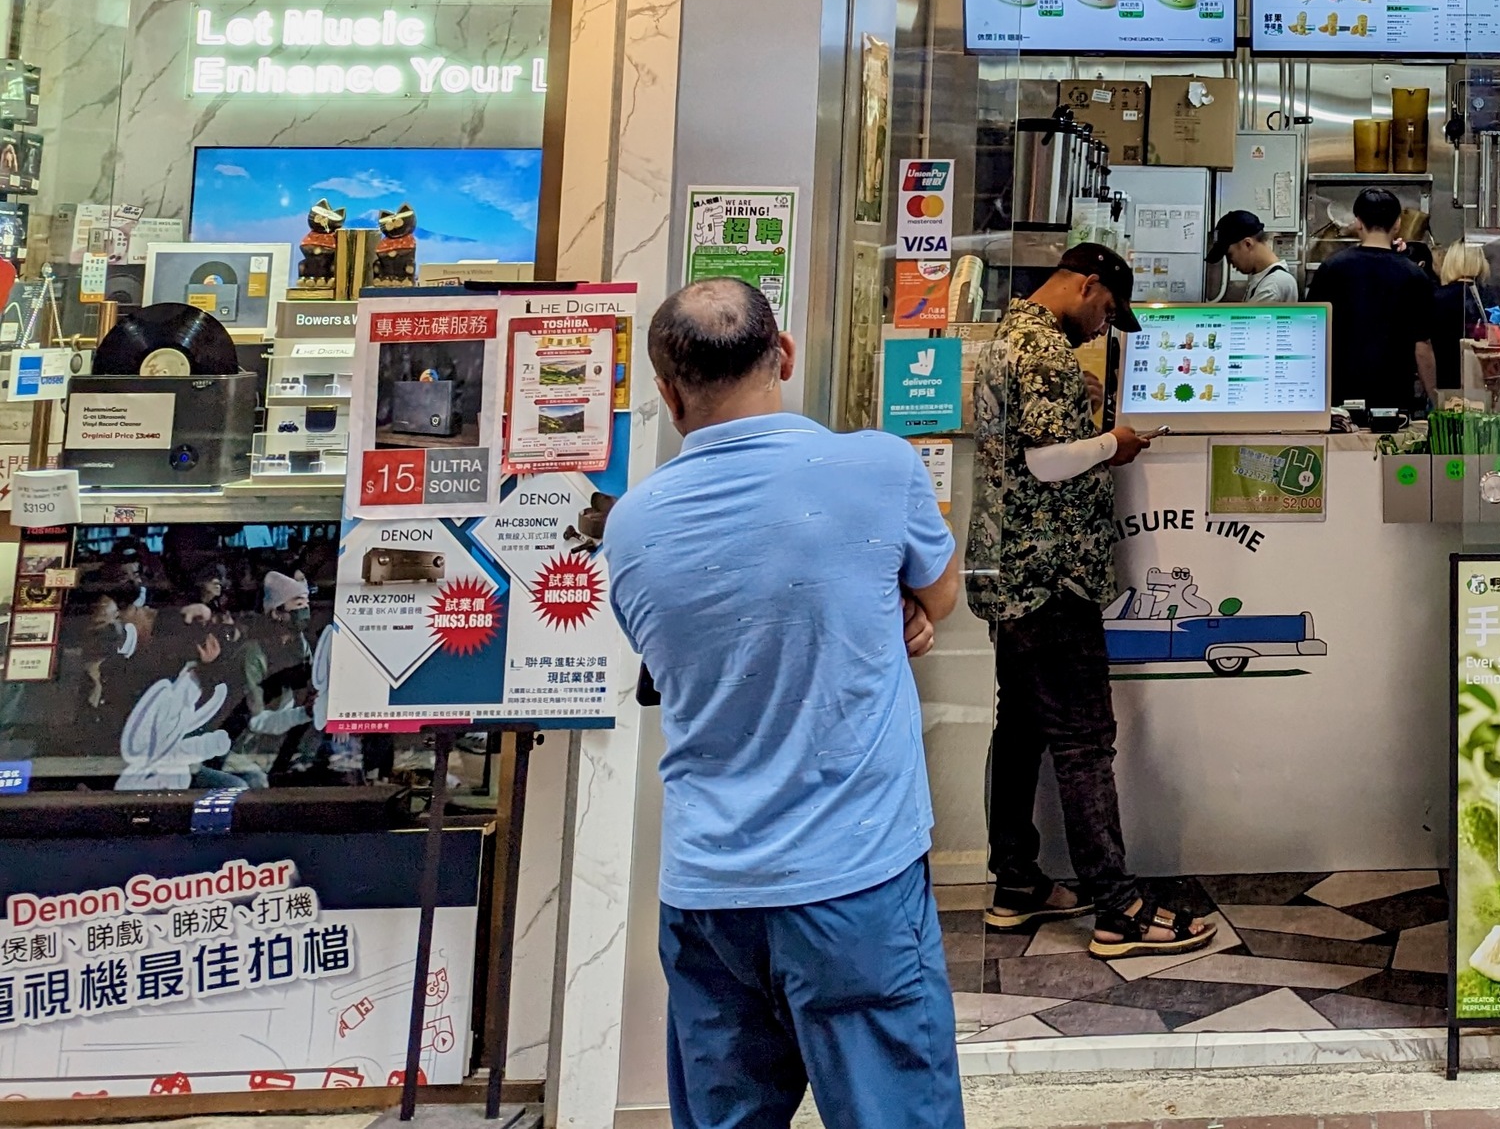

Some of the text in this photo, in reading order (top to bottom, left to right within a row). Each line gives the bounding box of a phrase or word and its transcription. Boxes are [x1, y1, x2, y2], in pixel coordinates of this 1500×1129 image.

[196, 9, 426, 46] Let Music
[192, 56, 402, 94] Enhance
[410, 56, 521, 94] Your
[907, 168, 947, 179] UnionPay
[725, 206, 770, 216] HIRING!
[722, 217, 783, 245] 招聘
[900, 235, 948, 252] VISA
[566, 299, 626, 314] DIGITAL
[296, 313, 342, 325] Bowers
[343, 315, 351, 325] &
[919, 312, 946, 320] Octopus
[375, 315, 488, 337] 專業洗碟服務
[542, 319, 589, 329] TOSHIBA
[318, 347, 350, 355] DIGITAL
[40, 376, 65, 385] Closed
[902, 377, 943, 386] deliveroo
[430, 458, 482, 473] ULTRA
[366, 463, 416, 495] $15
[429, 478, 481, 494] SONIC
[519, 492, 571, 506] DENON
[1282, 497, 1322, 510] $2,000
[23, 501, 56, 513] $3190
[494, 517, 559, 528] AH-C830NCW
[381, 528, 433, 542] DENON
[497, 531, 558, 541] 真無線入耳式耳機
[548, 573, 588, 587] 試業價
[346, 593, 416, 604] AVR-X2700H
[543, 589, 591, 604] HK$680
[444, 597, 485, 613] 試業價
[433, 613, 493, 629] HK$3,688
[554, 656, 608, 668] 進駐尖沙咀
[1465, 656, 1496, 669] Ever
[547, 670, 606, 683] 現試業優惠
[338, 722, 390, 731] 以上圖片只供參考
[12, 863, 290, 927] Denon Soundbar
